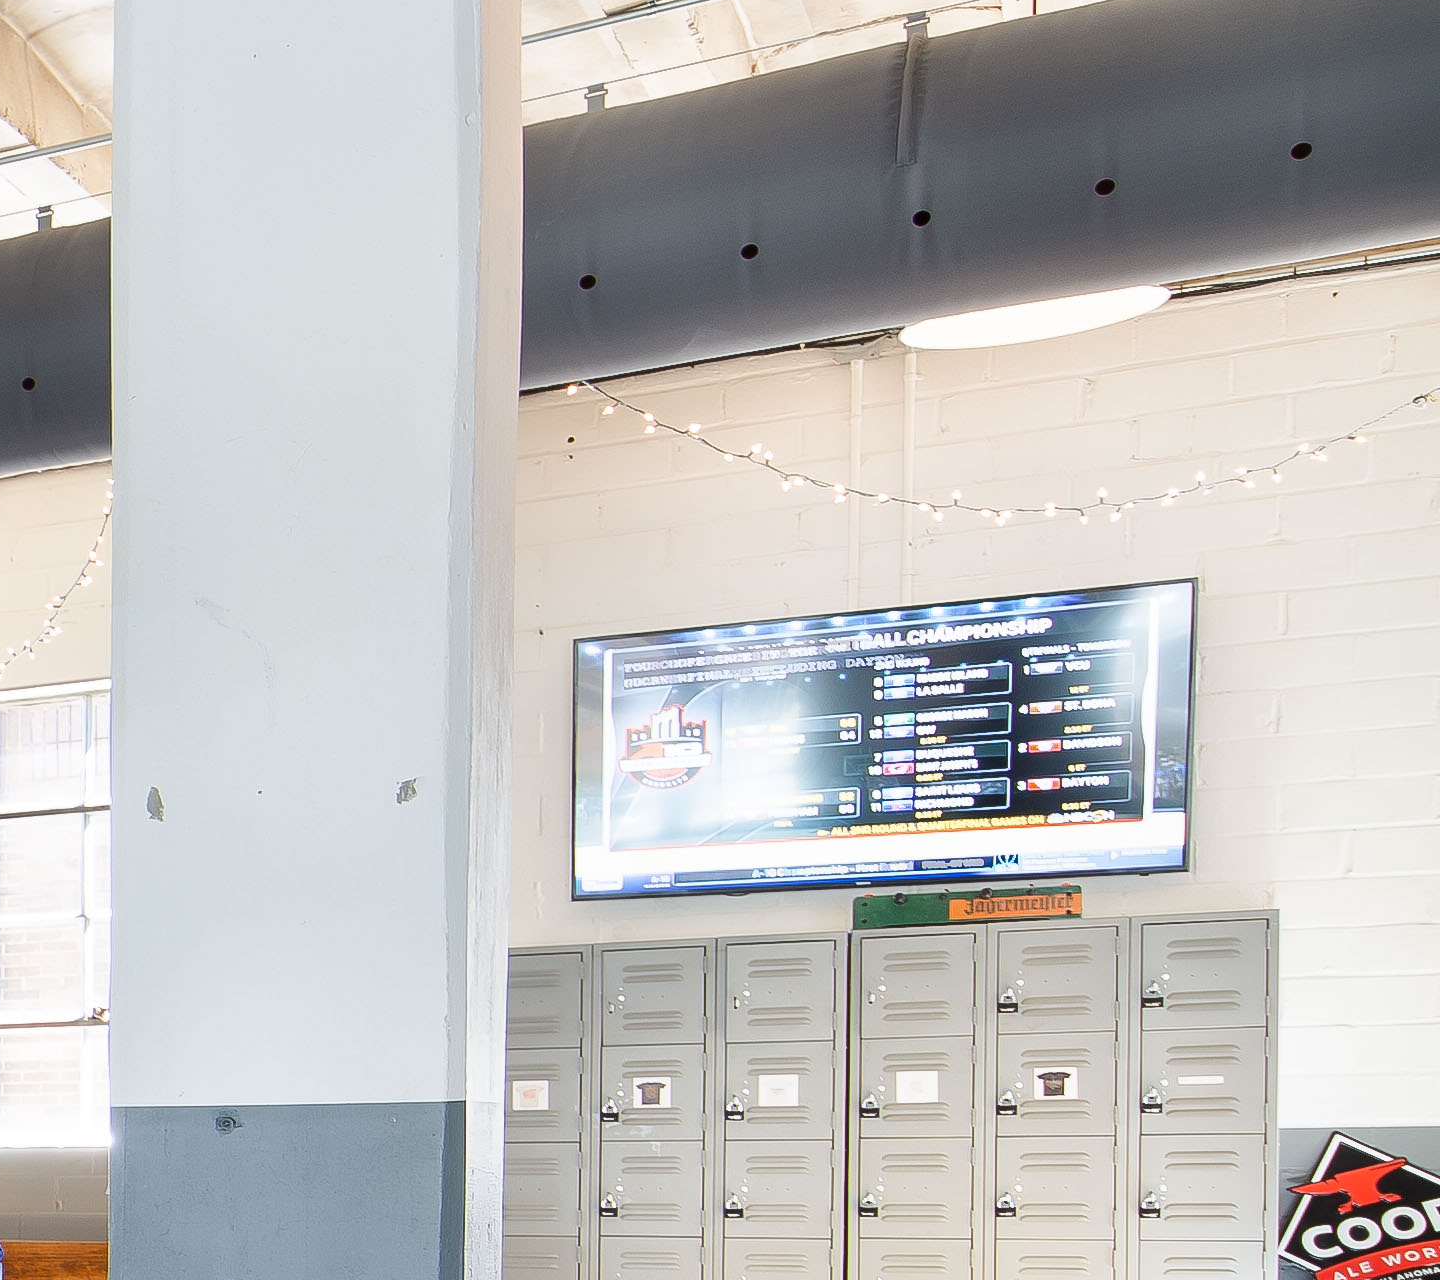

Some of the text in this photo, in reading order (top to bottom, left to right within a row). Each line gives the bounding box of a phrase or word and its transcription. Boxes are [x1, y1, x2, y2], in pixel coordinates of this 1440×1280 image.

[906, 618, 1054, 646] CHAMPIONSHIP
[1065, 659, 1092, 672] VCU
[1018, 704, 1029, 715] 4
[1063, 736, 1123, 750] DAVIDSON
[1061, 775, 1110, 789] DAYTON
[914, 796, 975, 810] RICHMOND
[1380, 1245, 1440, 1267] WOR
